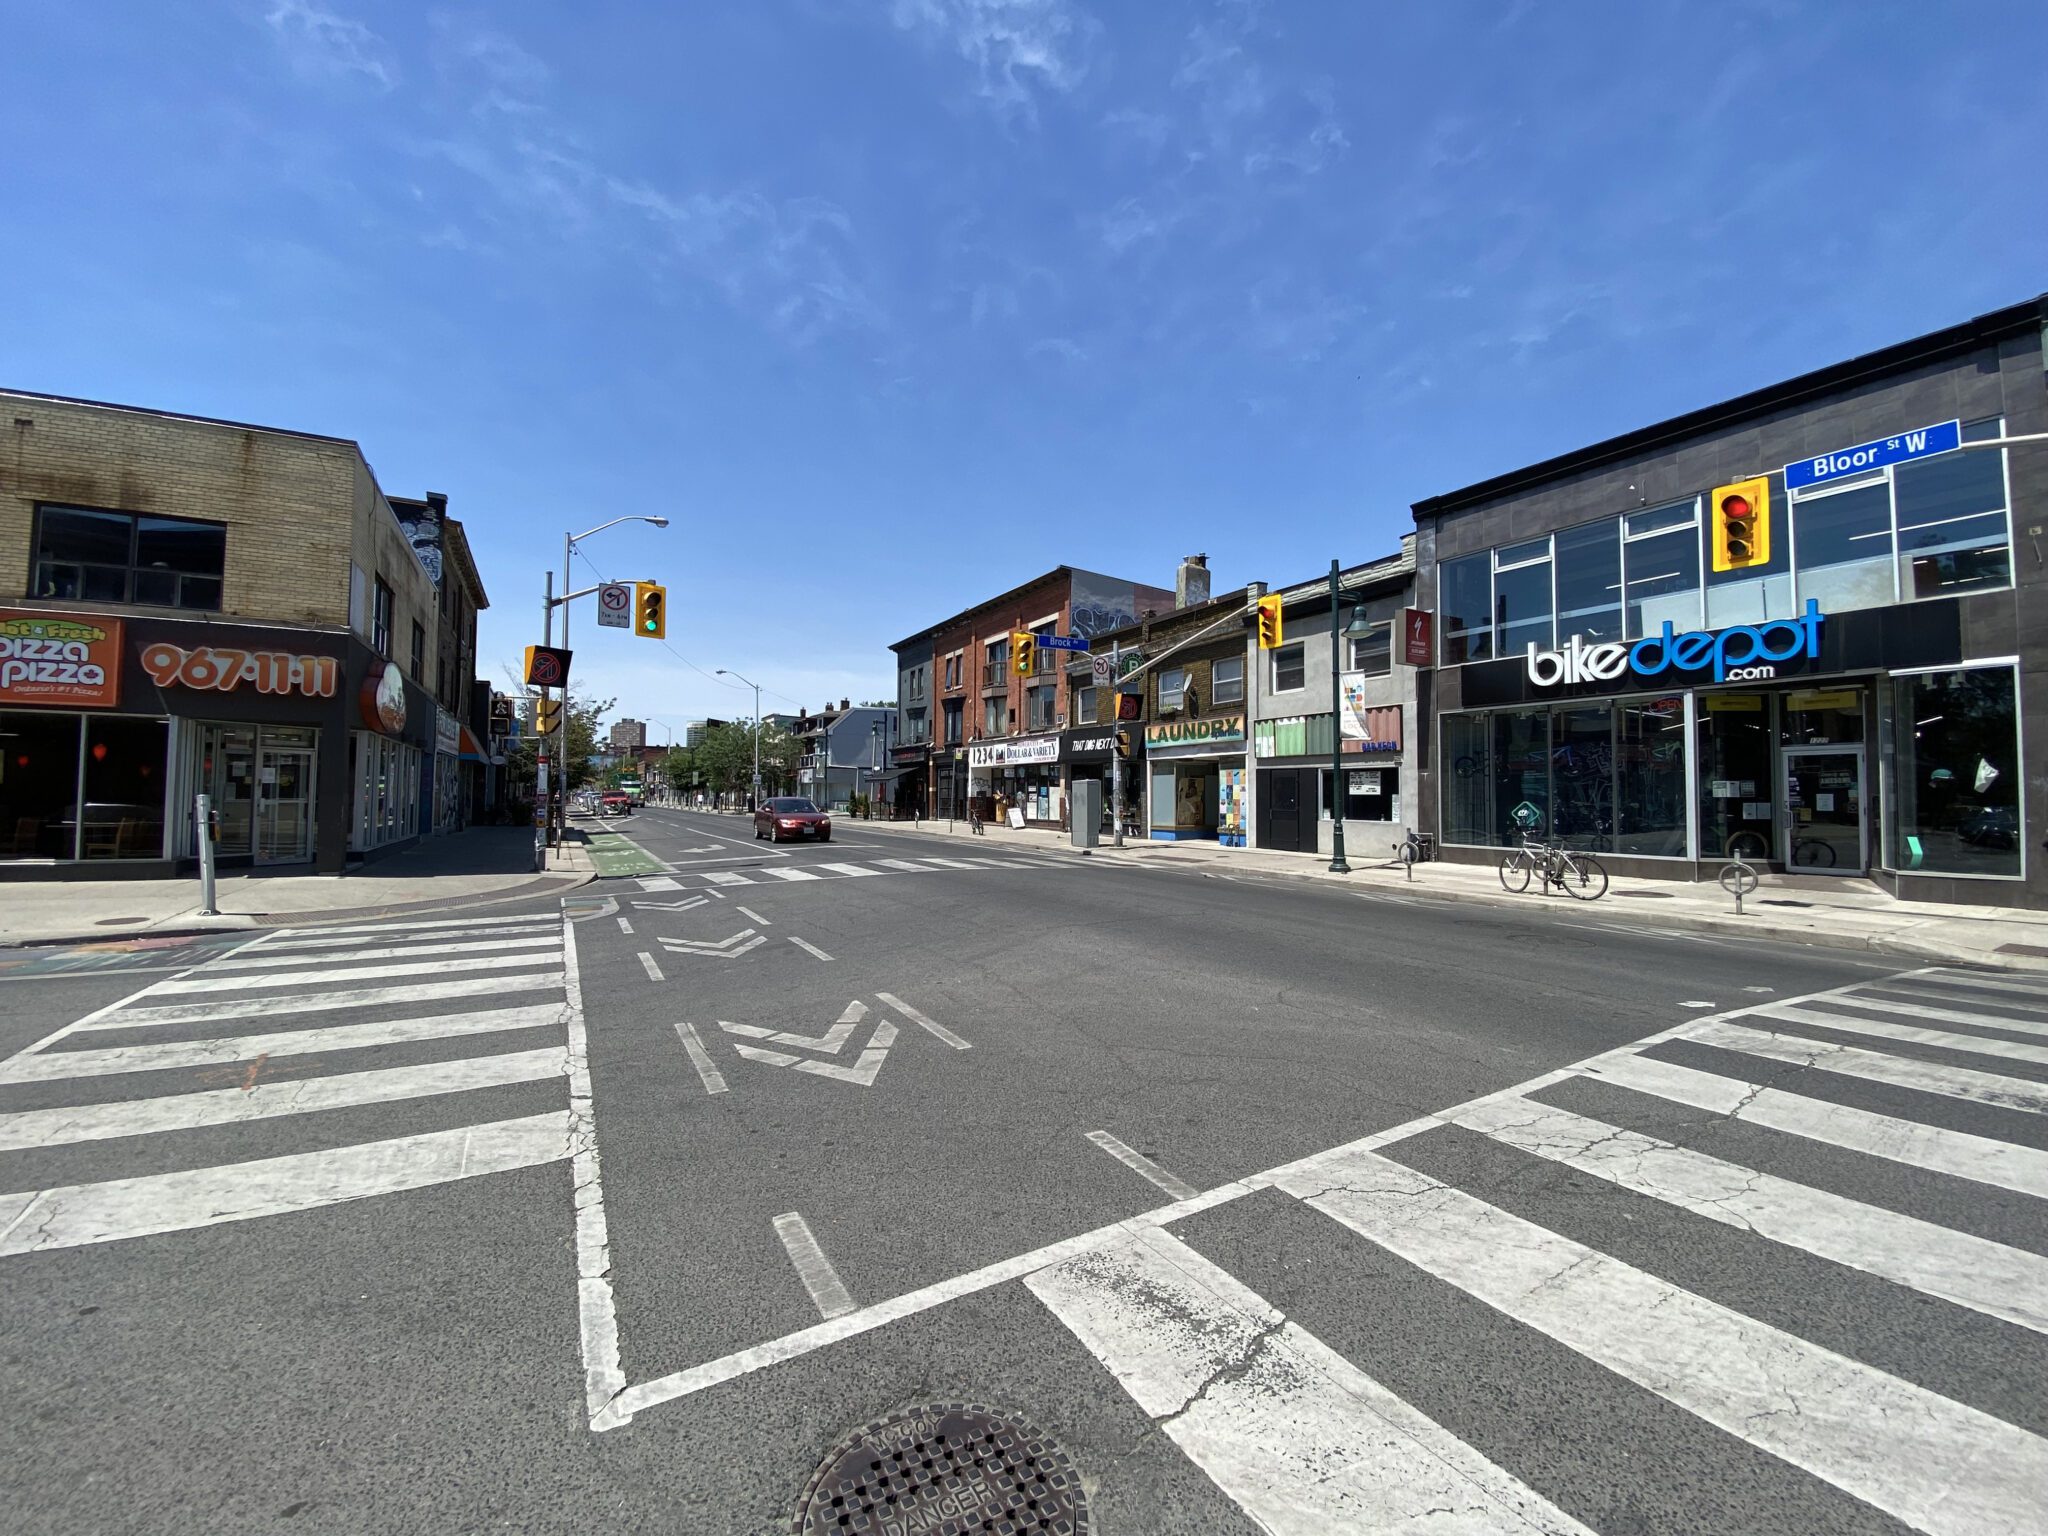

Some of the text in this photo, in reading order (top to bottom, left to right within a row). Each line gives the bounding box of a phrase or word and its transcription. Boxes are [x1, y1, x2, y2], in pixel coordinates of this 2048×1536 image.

[1813, 431, 1927, 477] Bloor St W
[46, 624, 106, 641] Fresh
[1049, 637, 1071, 647] Brock
[1527, 598, 1825, 687] bike depot
[1724, 665, 1775, 681] .com
[1147, 717, 1239, 744] LAUNDRY
[1007, 747, 1028, 759] DOLLAR
[1033, 742, 1056, 756] VARIETY
[1072, 740, 1085, 752] THAT
[1095, 737, 1111, 750] NEXT
[973, 747, 994, 765] 1234
[882, 1481, 996, 1536] DANGER
